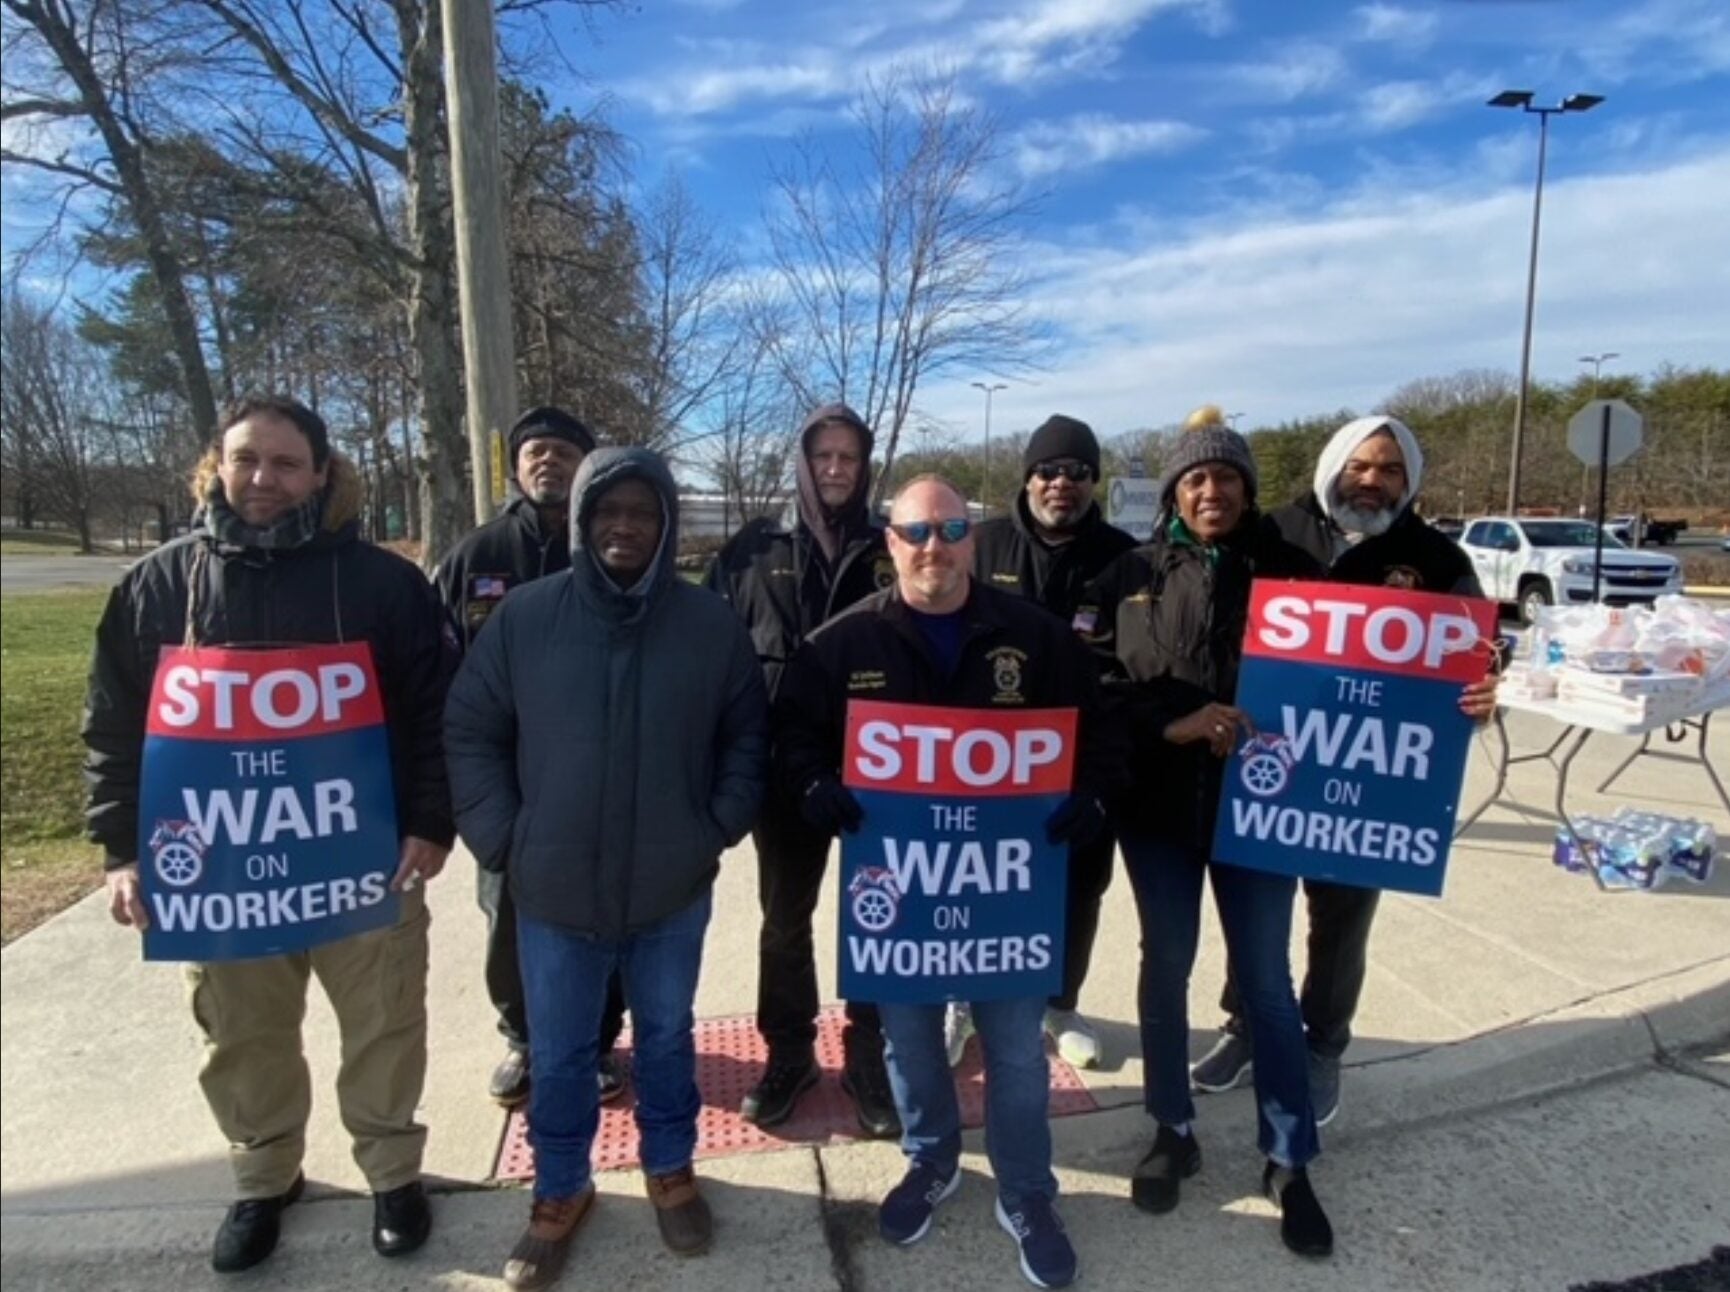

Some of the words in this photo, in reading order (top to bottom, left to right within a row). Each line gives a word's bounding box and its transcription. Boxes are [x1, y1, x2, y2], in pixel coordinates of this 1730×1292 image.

[1258, 595, 1481, 669] STOP
[158, 662, 366, 729] STOP
[1335, 675, 1383, 707] THE
[230, 749, 287, 777] THE
[855, 720, 1063, 786] STOP
[1280, 704, 1434, 780] WAR
[181, 778, 358, 846] WAR
[930, 804, 977, 831] THE
[1323, 778, 1362, 806] ON
[1231, 797, 1440, 867] WORKERS
[246, 853, 289, 881] ON
[882, 837, 1032, 896] WAR
[152, 871, 386, 932] WORKERS
[933, 906, 970, 930] ON
[847, 934, 1052, 976] WORKERS
